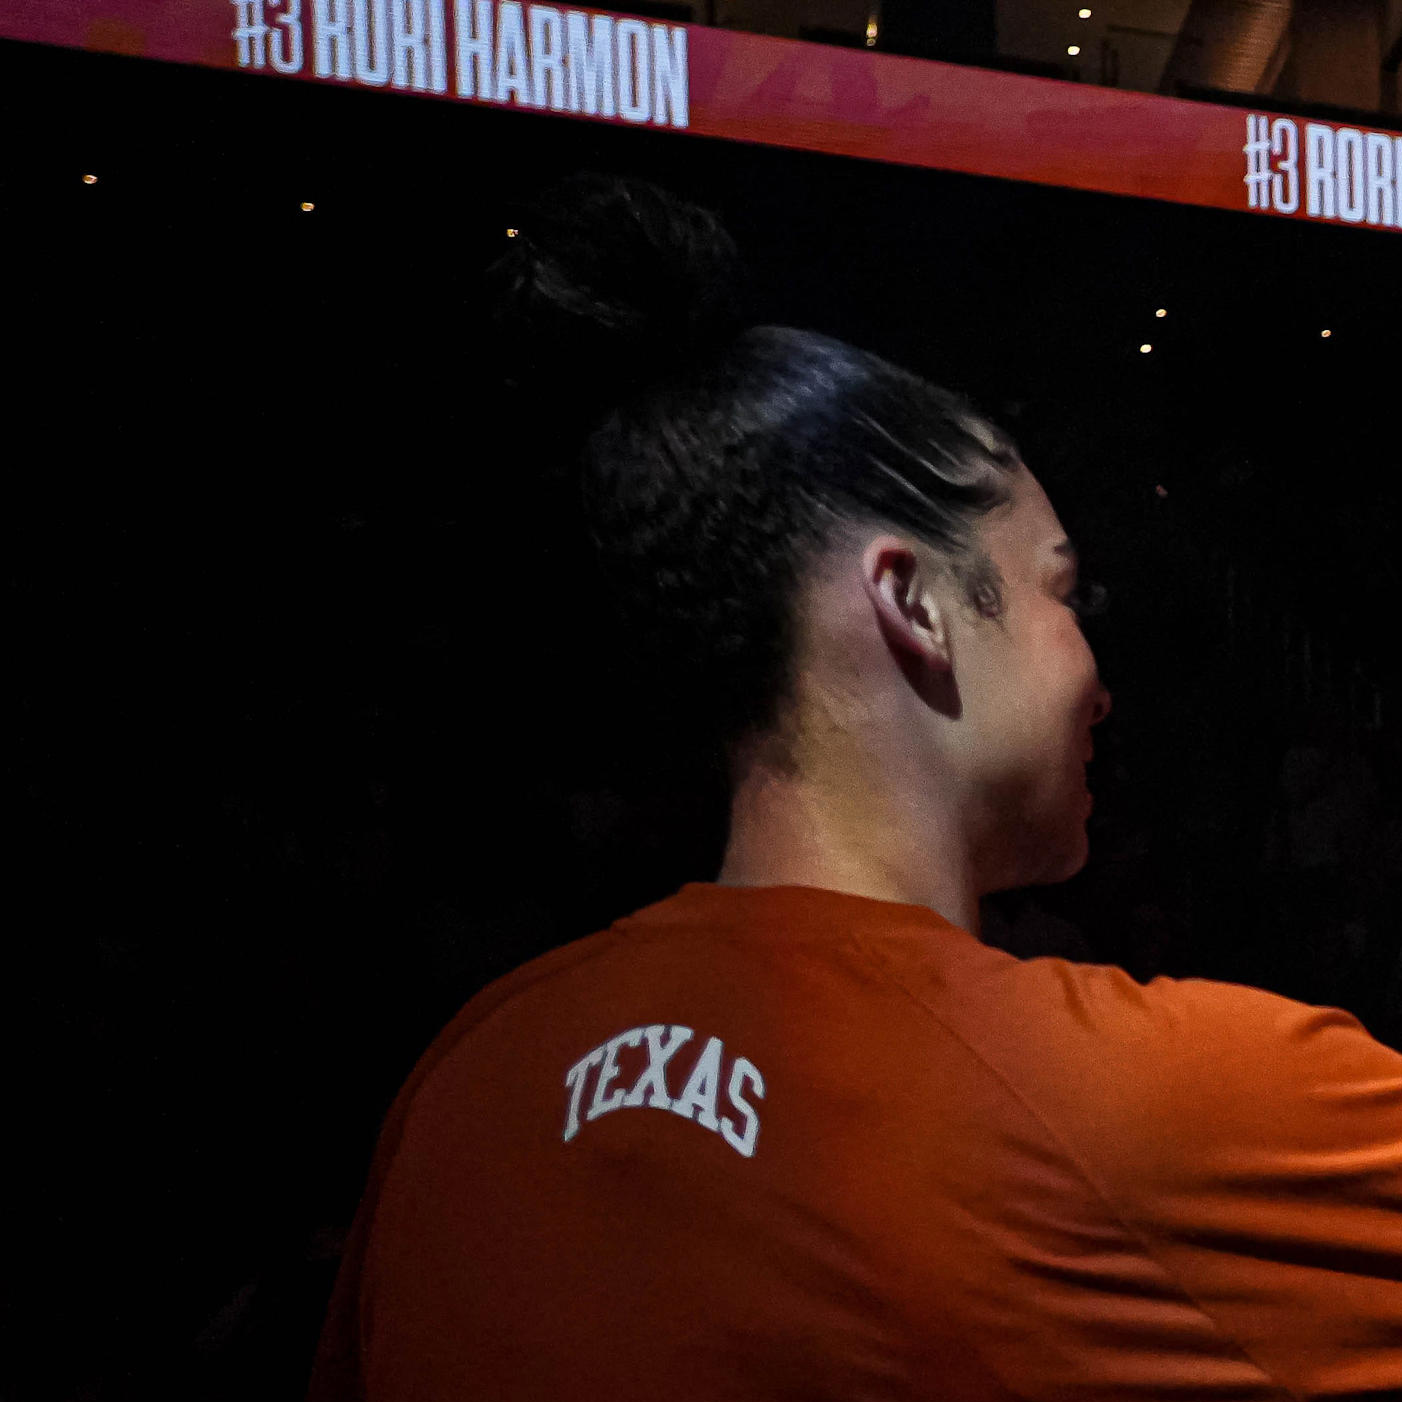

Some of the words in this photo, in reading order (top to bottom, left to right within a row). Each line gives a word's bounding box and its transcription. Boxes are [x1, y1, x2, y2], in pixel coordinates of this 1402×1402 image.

[312, 0, 448, 94] RORI
[453, 0, 690, 128] HARMON
[1243, 113, 1299, 215] #3
[563, 1023, 767, 1158] TEXAS
